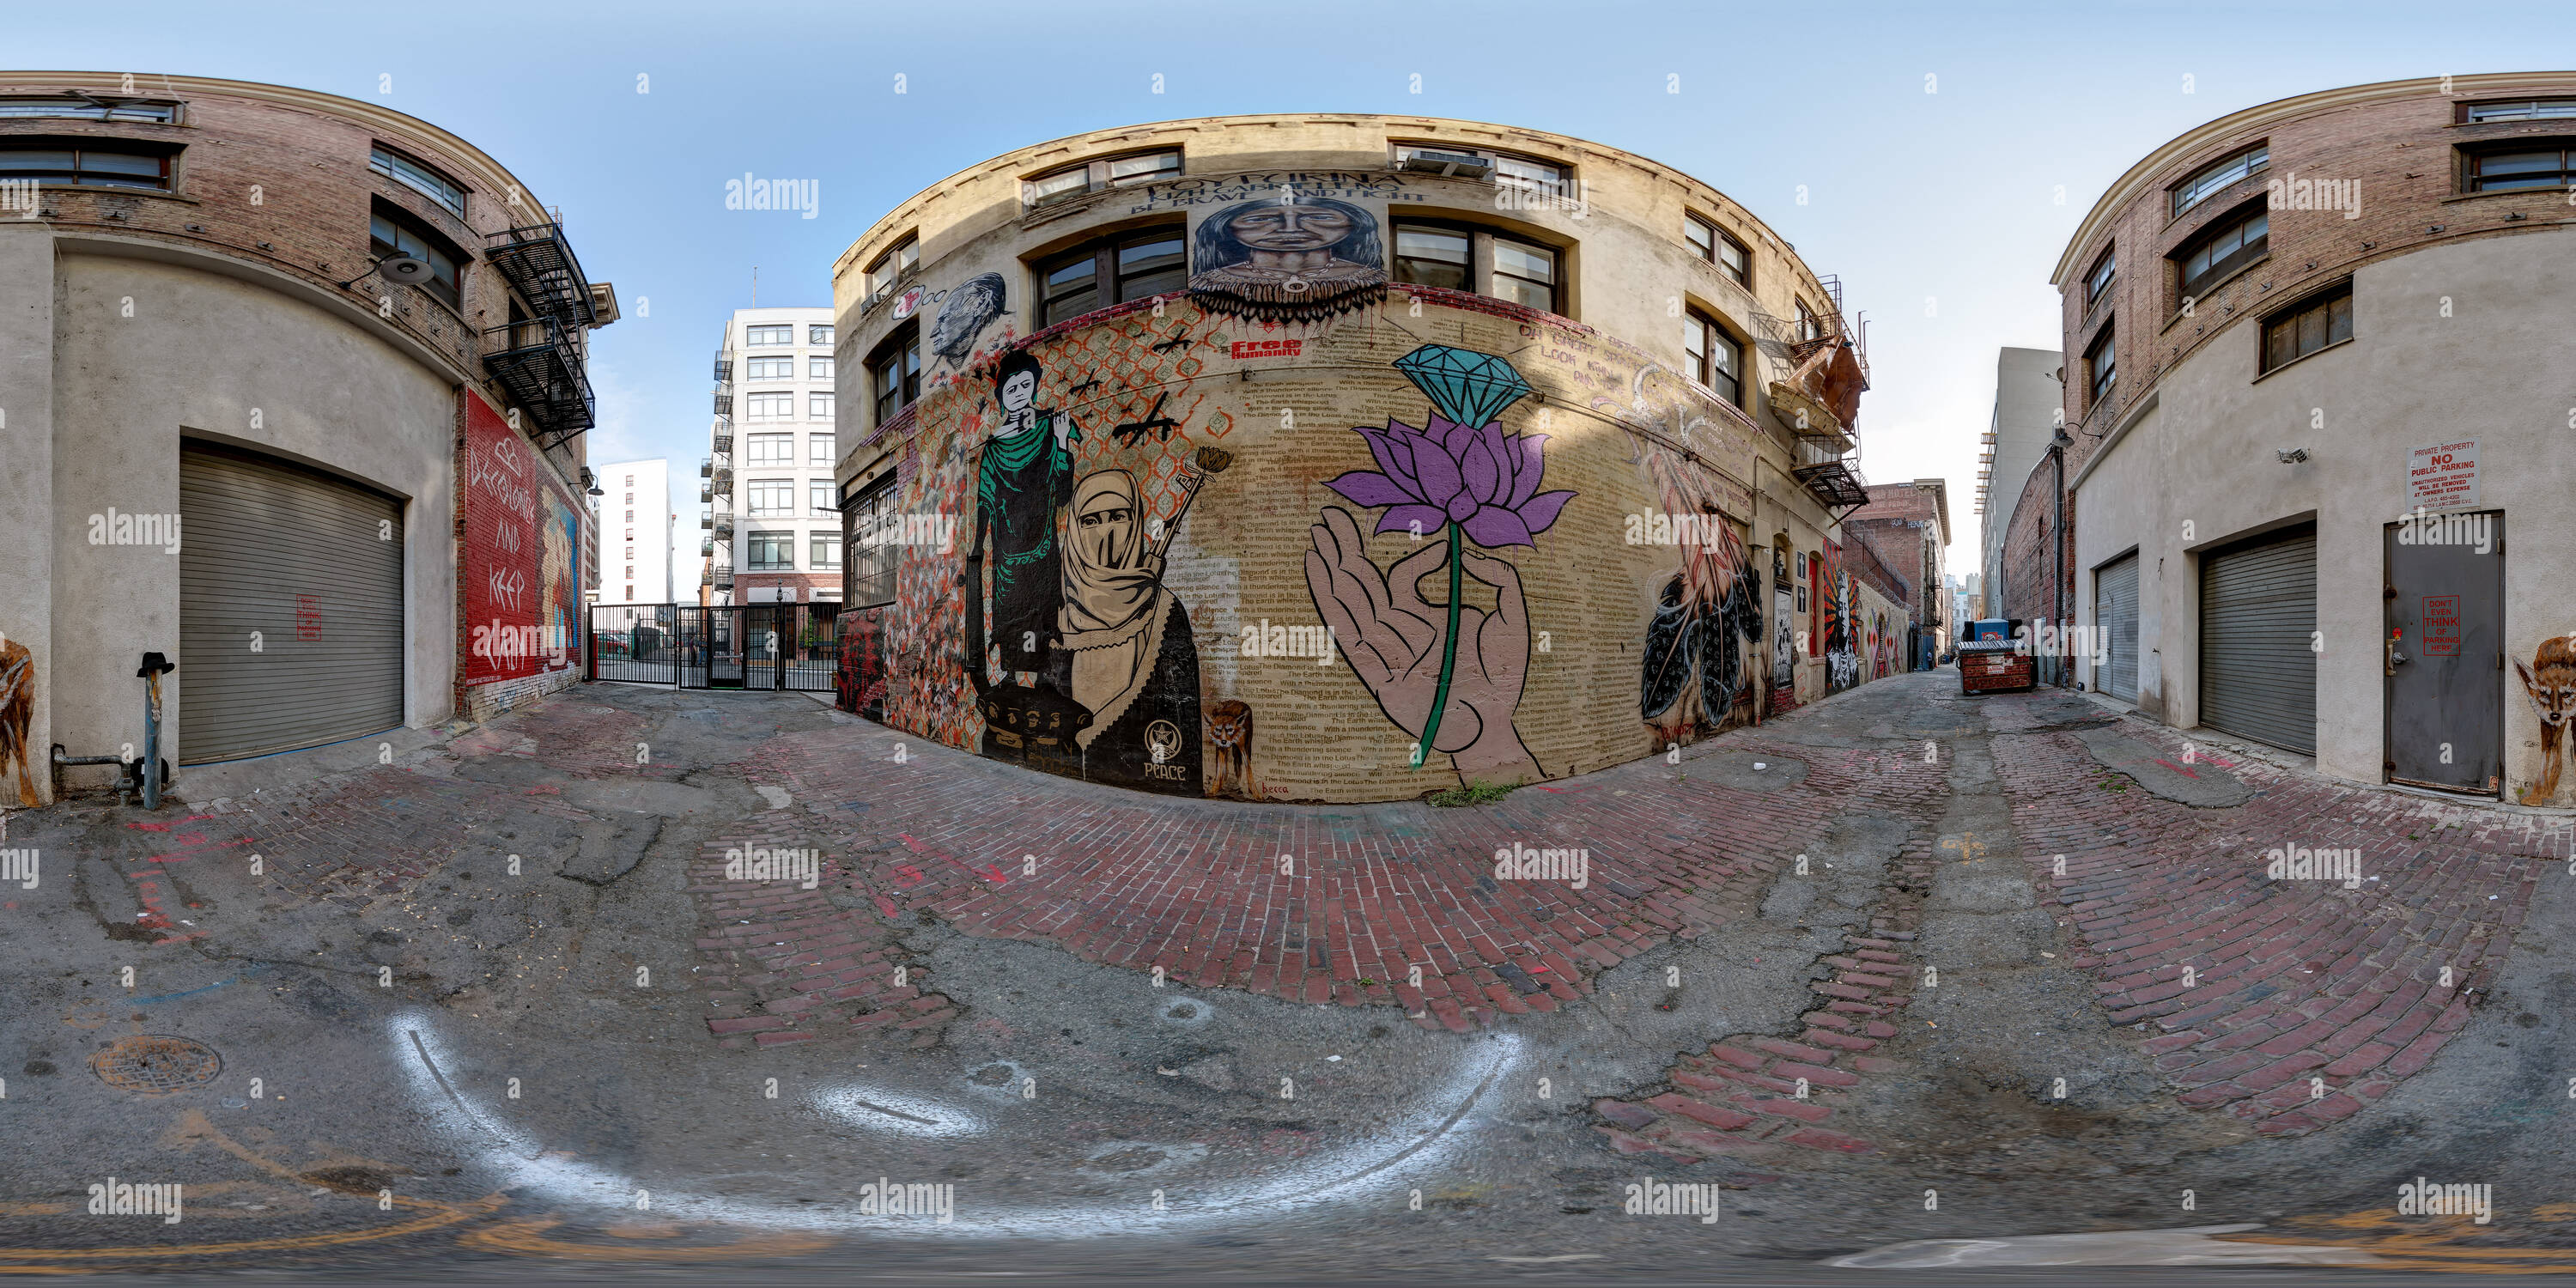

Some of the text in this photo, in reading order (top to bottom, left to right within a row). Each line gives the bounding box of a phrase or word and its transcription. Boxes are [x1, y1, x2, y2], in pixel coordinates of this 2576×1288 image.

[1131, 204, 1159, 215] BE
[1173, 191, 1256, 207] BRAVE
[1231, 339, 1303, 353] Free
[1231, 349, 1301, 360] Humanity
[1541, 345, 1577, 366] LOOK
[2415, 441, 2475, 457] PRIVATE PROPERTY
[2431, 453, 2453, 465] NO
[2411, 460, 2475, 477] PUBLIC PARKING
[2411, 476, 2447, 486] UNAUTHORIZED
[495, 518, 520, 555] AND
[489, 562, 525, 613] KEEP
[2429, 599, 2452, 608] DON'T
[2425, 617, 2458, 627] THINK
[1144, 762, 1187, 781] PEACE
[1262, 782, 1289, 794] becca
